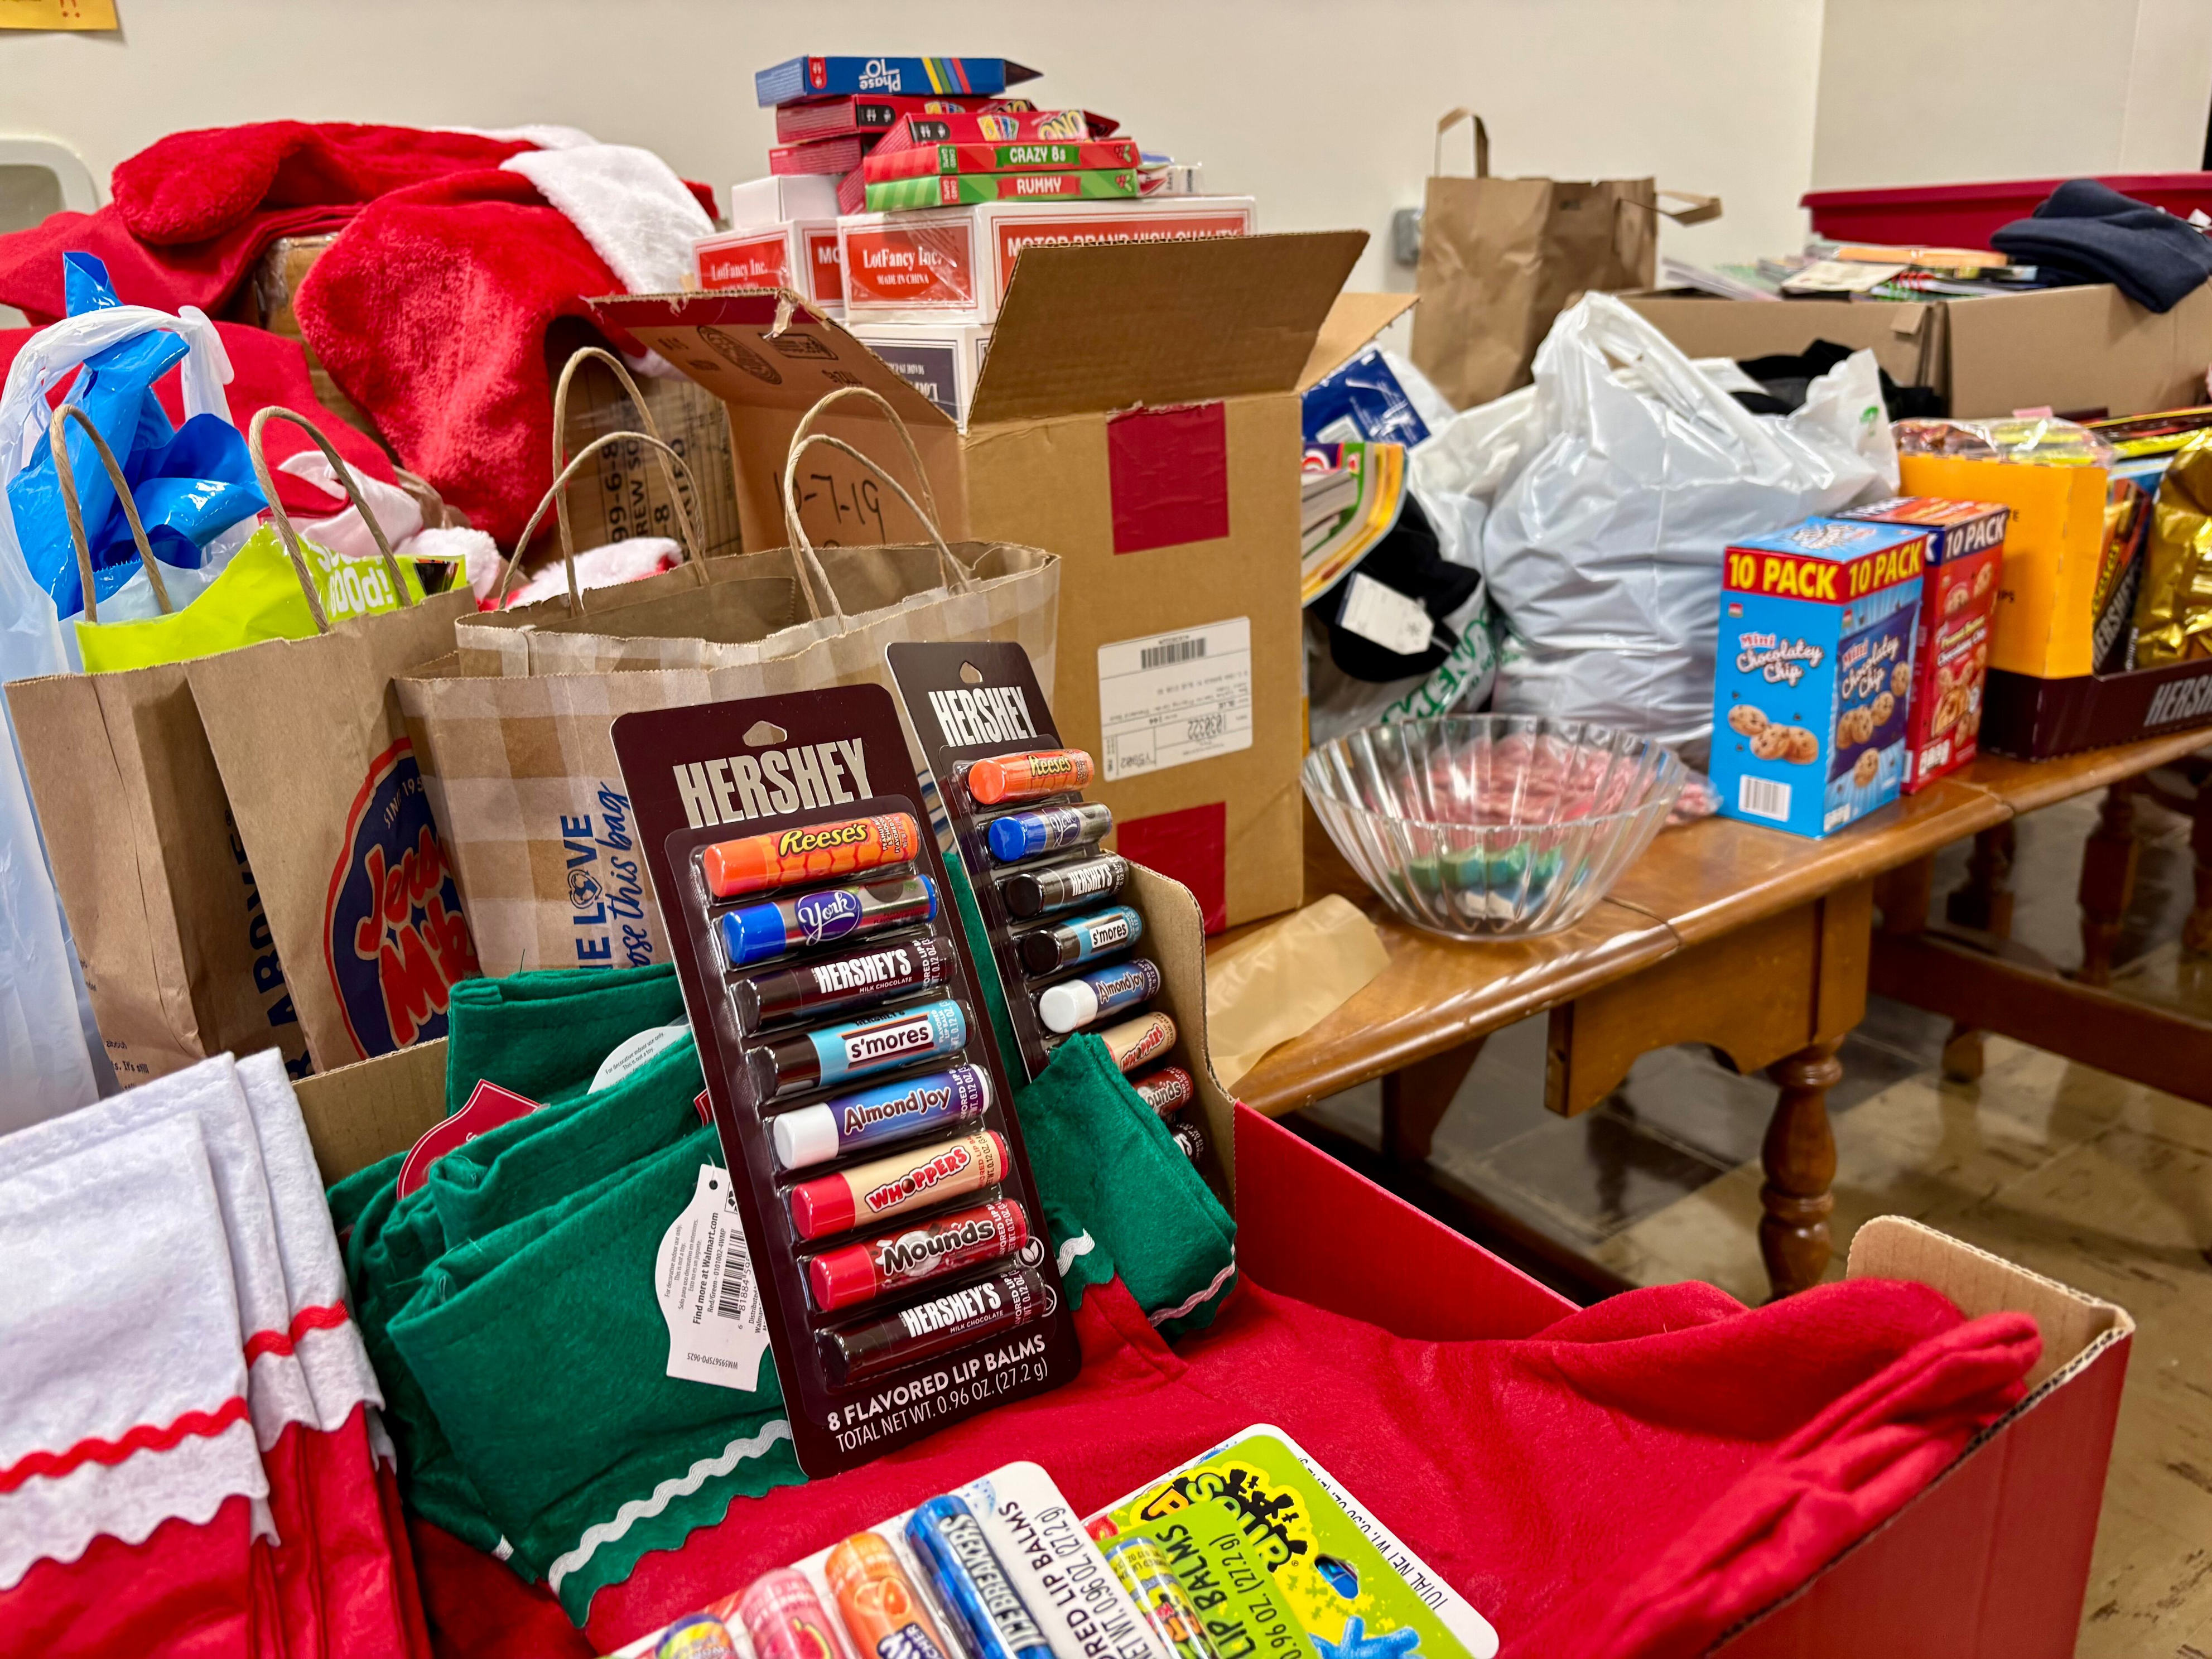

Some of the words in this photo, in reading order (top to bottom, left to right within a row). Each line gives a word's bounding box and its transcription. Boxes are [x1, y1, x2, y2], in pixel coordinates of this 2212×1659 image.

[859, 74, 901, 93] Phase
[865, 59, 900, 79] 10
[1010, 146, 1048, 163] CRAZY
[1052, 145, 1065, 161] 8s
[1017, 177, 1061, 194] RUMMY
[711, 262, 748, 282] LotFancy
[863, 250, 914, 271] LotFancy
[918, 246, 942, 265] Inc.
[905, 273, 929, 284] CHINA
[1946, 530, 1962, 559] 10
[1964, 513, 2007, 552] PACK
[1729, 554, 1755, 589] 10
[1763, 558, 1840, 600] PACK
[1849, 560, 1870, 597] 10
[1873, 541, 1922, 589] PACK
[1737, 638, 1825, 673] Chocolatey
[1763, 660, 1804, 687] Chip
[928, 687, 1038, 747] HERSHEY
[673, 737, 874, 830] HERSHEY
[605, 855, 644, 920] this
[1067, 864, 1112, 896] HERSHEY'S
[798, 891, 857, 946] York
[1093, 923, 1126, 945] s'mores
[816, 948, 913, 994] HERSHEY'S
[860, 985, 874, 994] MILK
[876, 976, 913, 990] CHOCOLATE
[851, 1023, 930, 1059] s'mores
[931, 1009, 943, 1043] FLAVORED
[948, 1017, 958, 1033] 0.12
[967, 1083, 979, 1100] 0.12
[1146, 1081, 1183, 1110] ounds
[866, 1146, 971, 1213] WHOPPERS
[702, 1212, 719, 1268] Walmart.com
[884, 1219, 996, 1276] Mounds
[666, 1262, 676, 1289] decorative
[683, 1250, 693, 1276] decorativo
[701, 1269, 709, 1279] at
[707, 1280, 719, 1313] Red/Green
[713, 1228, 727, 1276] 0101002-4WMP
[697, 1280, 707, 1304] more
[738, 1279, 750, 1311] 81884
[692, 1304, 703, 1324] Find
[903, 1282, 1002, 1338] HERSHEY'S
[950, 1324, 965, 1334] MILK
[966, 1310, 1004, 1328] CHOCOLATE
[827, 1412, 840, 1431] 8
[845, 1372, 949, 1425] FLAVORED
[952, 1358, 980, 1382] LIP
[986, 1334, 1045, 1372] BALMS
[836, 1422, 881, 1453] TOTAL
[882, 1411, 909, 1435] NET
[909, 1401, 937, 1425] WT.
[937, 1387, 970, 1414] 0.96
[971, 1378, 995, 1401] OZ.
[995, 1364, 1033, 1396] (27.2
[1034, 1357, 1048, 1381] g)
[997, 1501, 1050, 1570] BALMS
[939, 1513, 1019, 1613] BREAKERS
[1065, 1551, 1098, 1581] OZ.
[1155, 1524, 1227, 1611] BALMS
[1042, 1572, 1077, 1607] LIP
[1081, 1578, 1118, 1614] 0.96
[1249, 1593, 1278, 1623] OZ.
